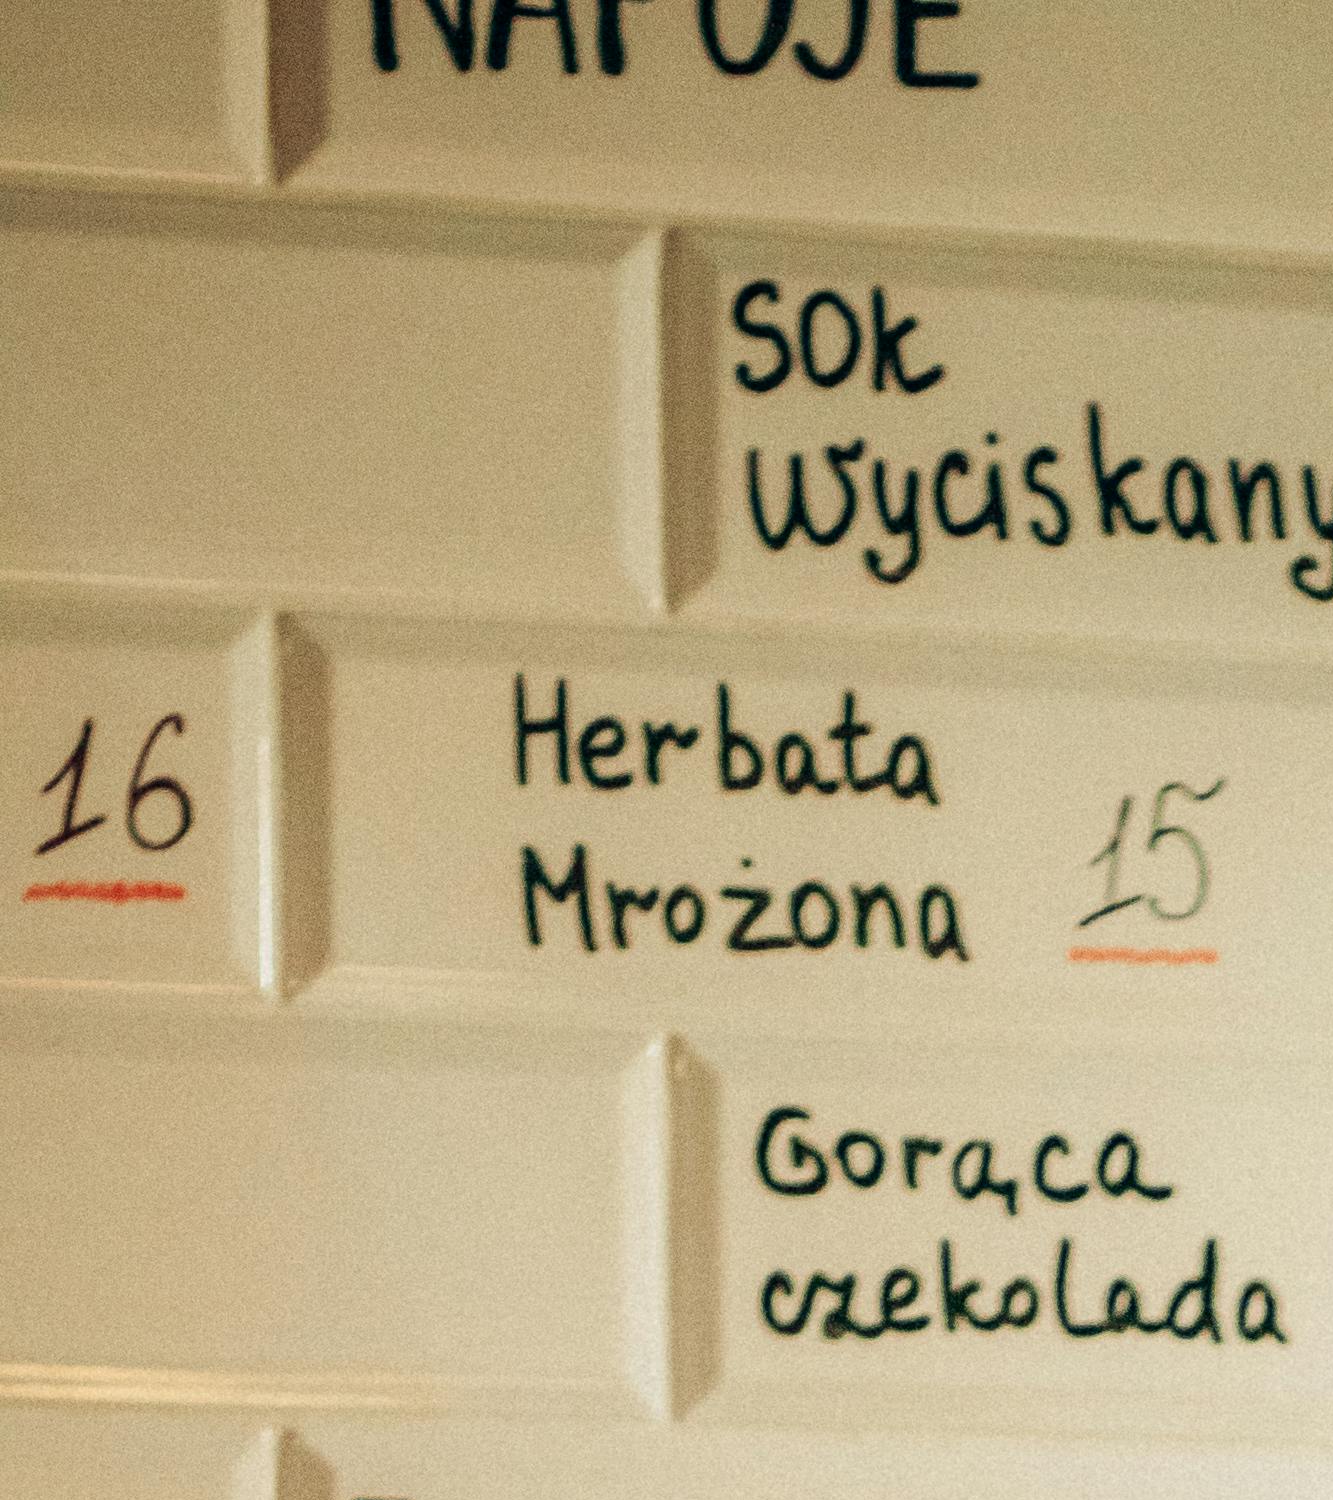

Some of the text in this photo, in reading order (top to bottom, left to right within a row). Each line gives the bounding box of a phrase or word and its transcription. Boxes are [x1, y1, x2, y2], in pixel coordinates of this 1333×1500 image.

[33, 711, 195, 857] 16
[511, 670, 942, 808] Herbata
[519, 842, 971, 964] Mrożona
[1077, 778, 1228, 929] 15
[753, 1104, 1176, 1216] Gorąca
